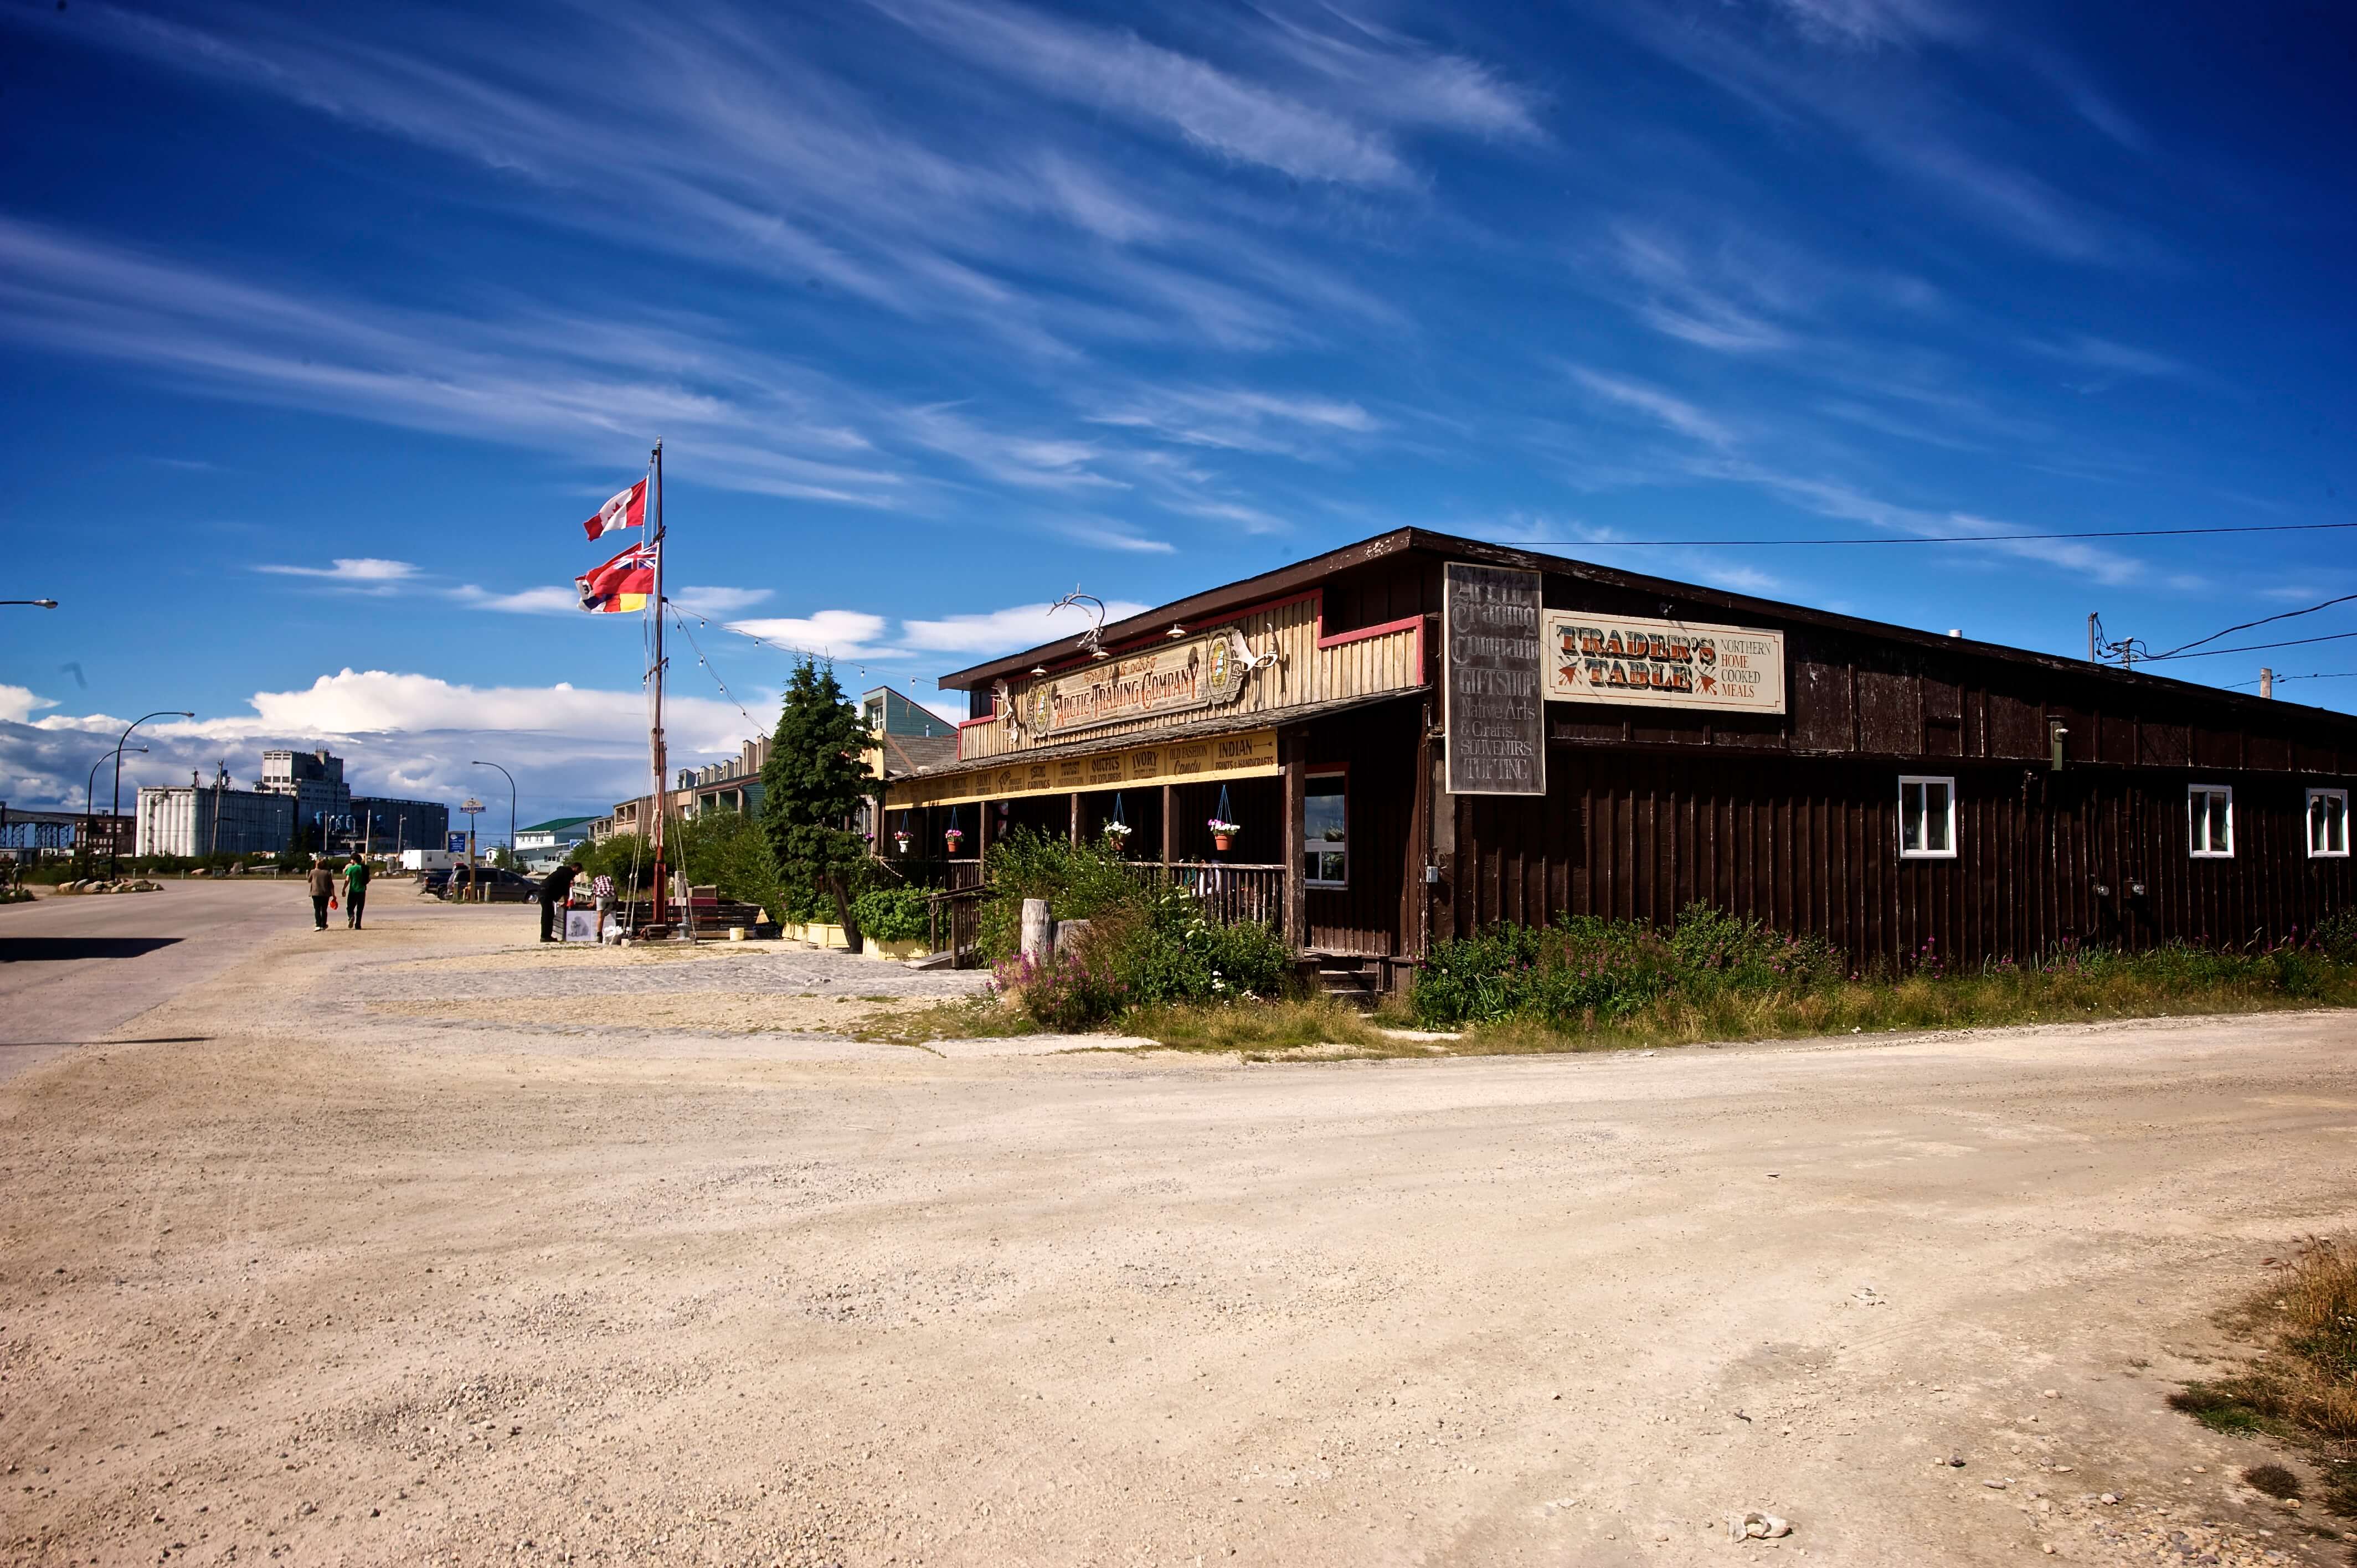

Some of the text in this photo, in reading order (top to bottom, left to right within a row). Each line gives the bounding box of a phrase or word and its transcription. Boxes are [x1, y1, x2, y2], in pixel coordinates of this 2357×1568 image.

[1452, 597, 1538, 639] Trading
[1451, 635, 1539, 670] Company
[1556, 625, 1716, 667] TRADER'S
[1720, 638, 1772, 656] NORTHERN
[1721, 653, 1749, 668] HOME
[1459, 669, 1536, 697] GIFT SHOP
[1584, 657, 1693, 694] TABLE
[1721, 668, 1761, 684] COOKED
[1091, 682, 1139, 718] TRADING
[1141, 662, 1200, 710] COMPANY
[1722, 683, 1755, 698] MEALS
[1461, 697, 1536, 720] Native Arts
[1460, 720, 1470, 736] &
[1170, 744, 1208, 760] OLD FASHION
[1218, 739, 1253, 758] INDIAN
[1131, 751, 1159, 769] IVORY
[1174, 759, 1201, 777] Candy
[1216, 761, 1233, 770] PRINTS
[1238, 756, 1274, 768] HANDICRAFTS
[1464, 757, 1528, 780] TUFTING
[976, 773, 992, 786] ARMY
[1028, 780, 1051, 790] CARVINGS
